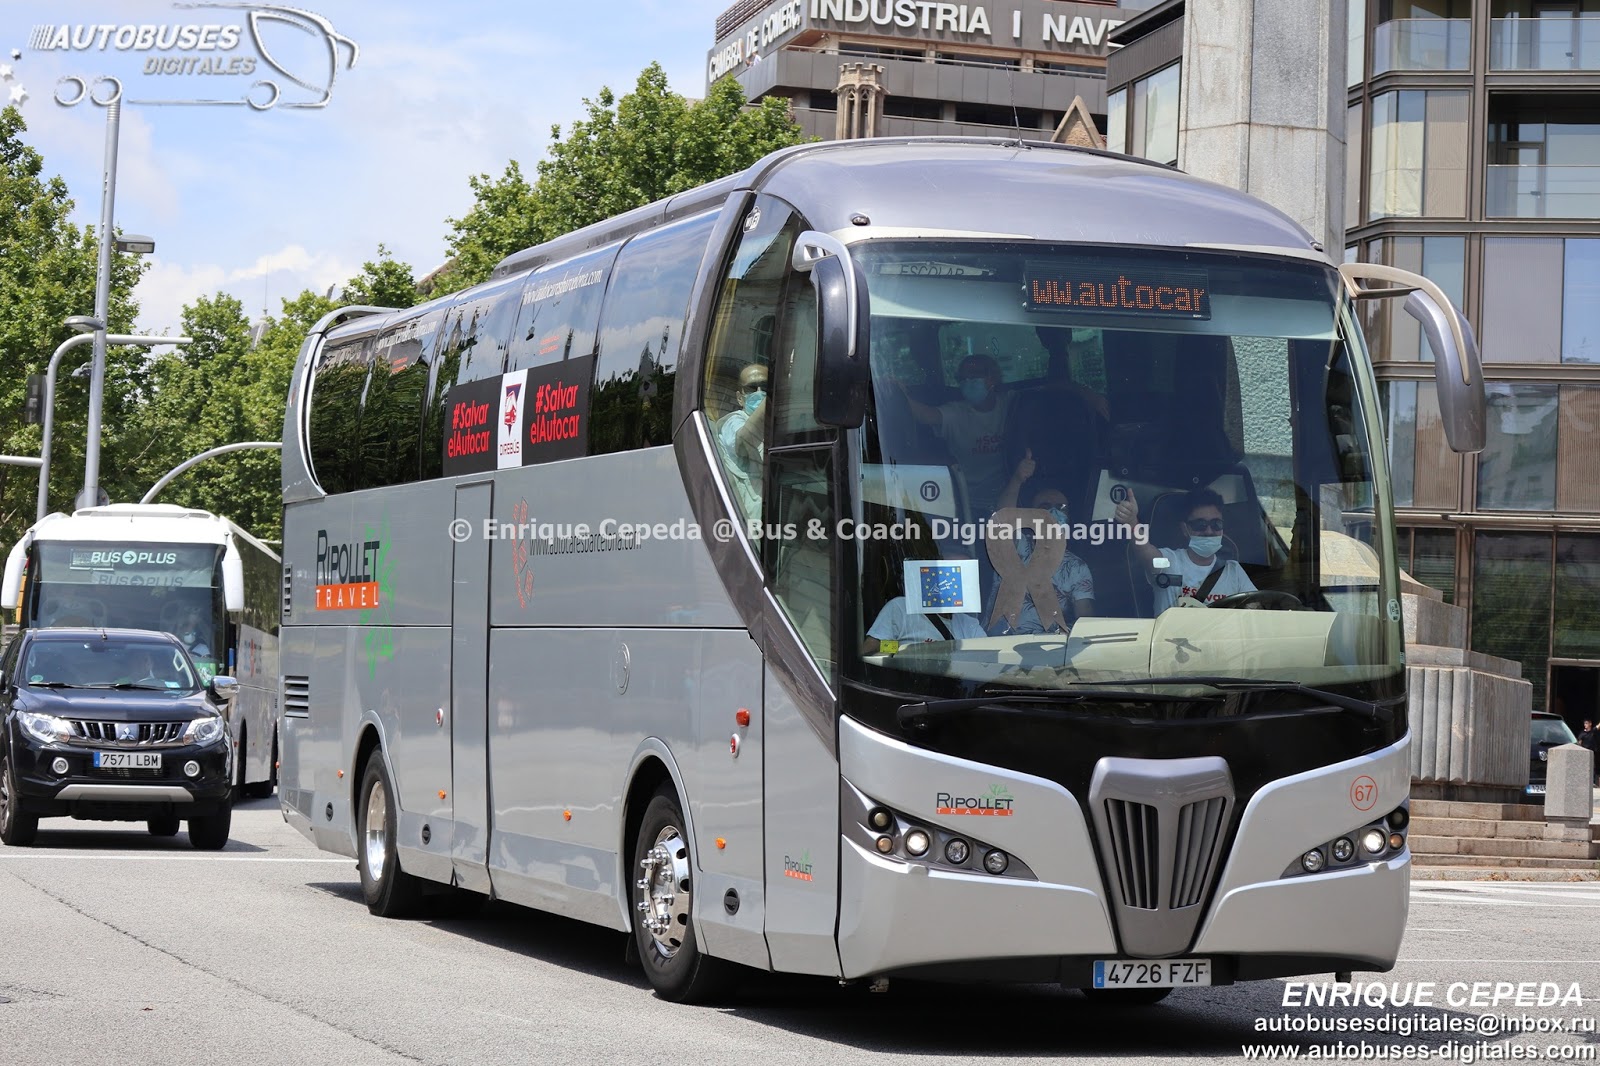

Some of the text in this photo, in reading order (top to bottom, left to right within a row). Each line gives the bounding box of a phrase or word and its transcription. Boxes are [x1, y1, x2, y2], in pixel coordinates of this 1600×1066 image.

[810, 0, 992, 35] INDUSTRIA
[1013, 10, 1021, 38] I
[746, 26, 760, 58] DE
[534, 381, 579, 414] #Salvar
[452, 399, 490, 430] #Salvar
[530, 412, 580, 445] elAutocar
[447, 428, 491, 458] elAutocar
[91, 551, 121, 563] BUS
[137, 552, 177, 564] PLUS
[315, 586, 379, 608] TRAVEL
[102, 754, 159, 766] 7571 LBM
[1355, 785, 1373, 801] 67
[936, 808, 1013, 816] TRAVEL
[1108, 963, 1162, 984] 4726
[1169, 962, 1207, 983] FZF
